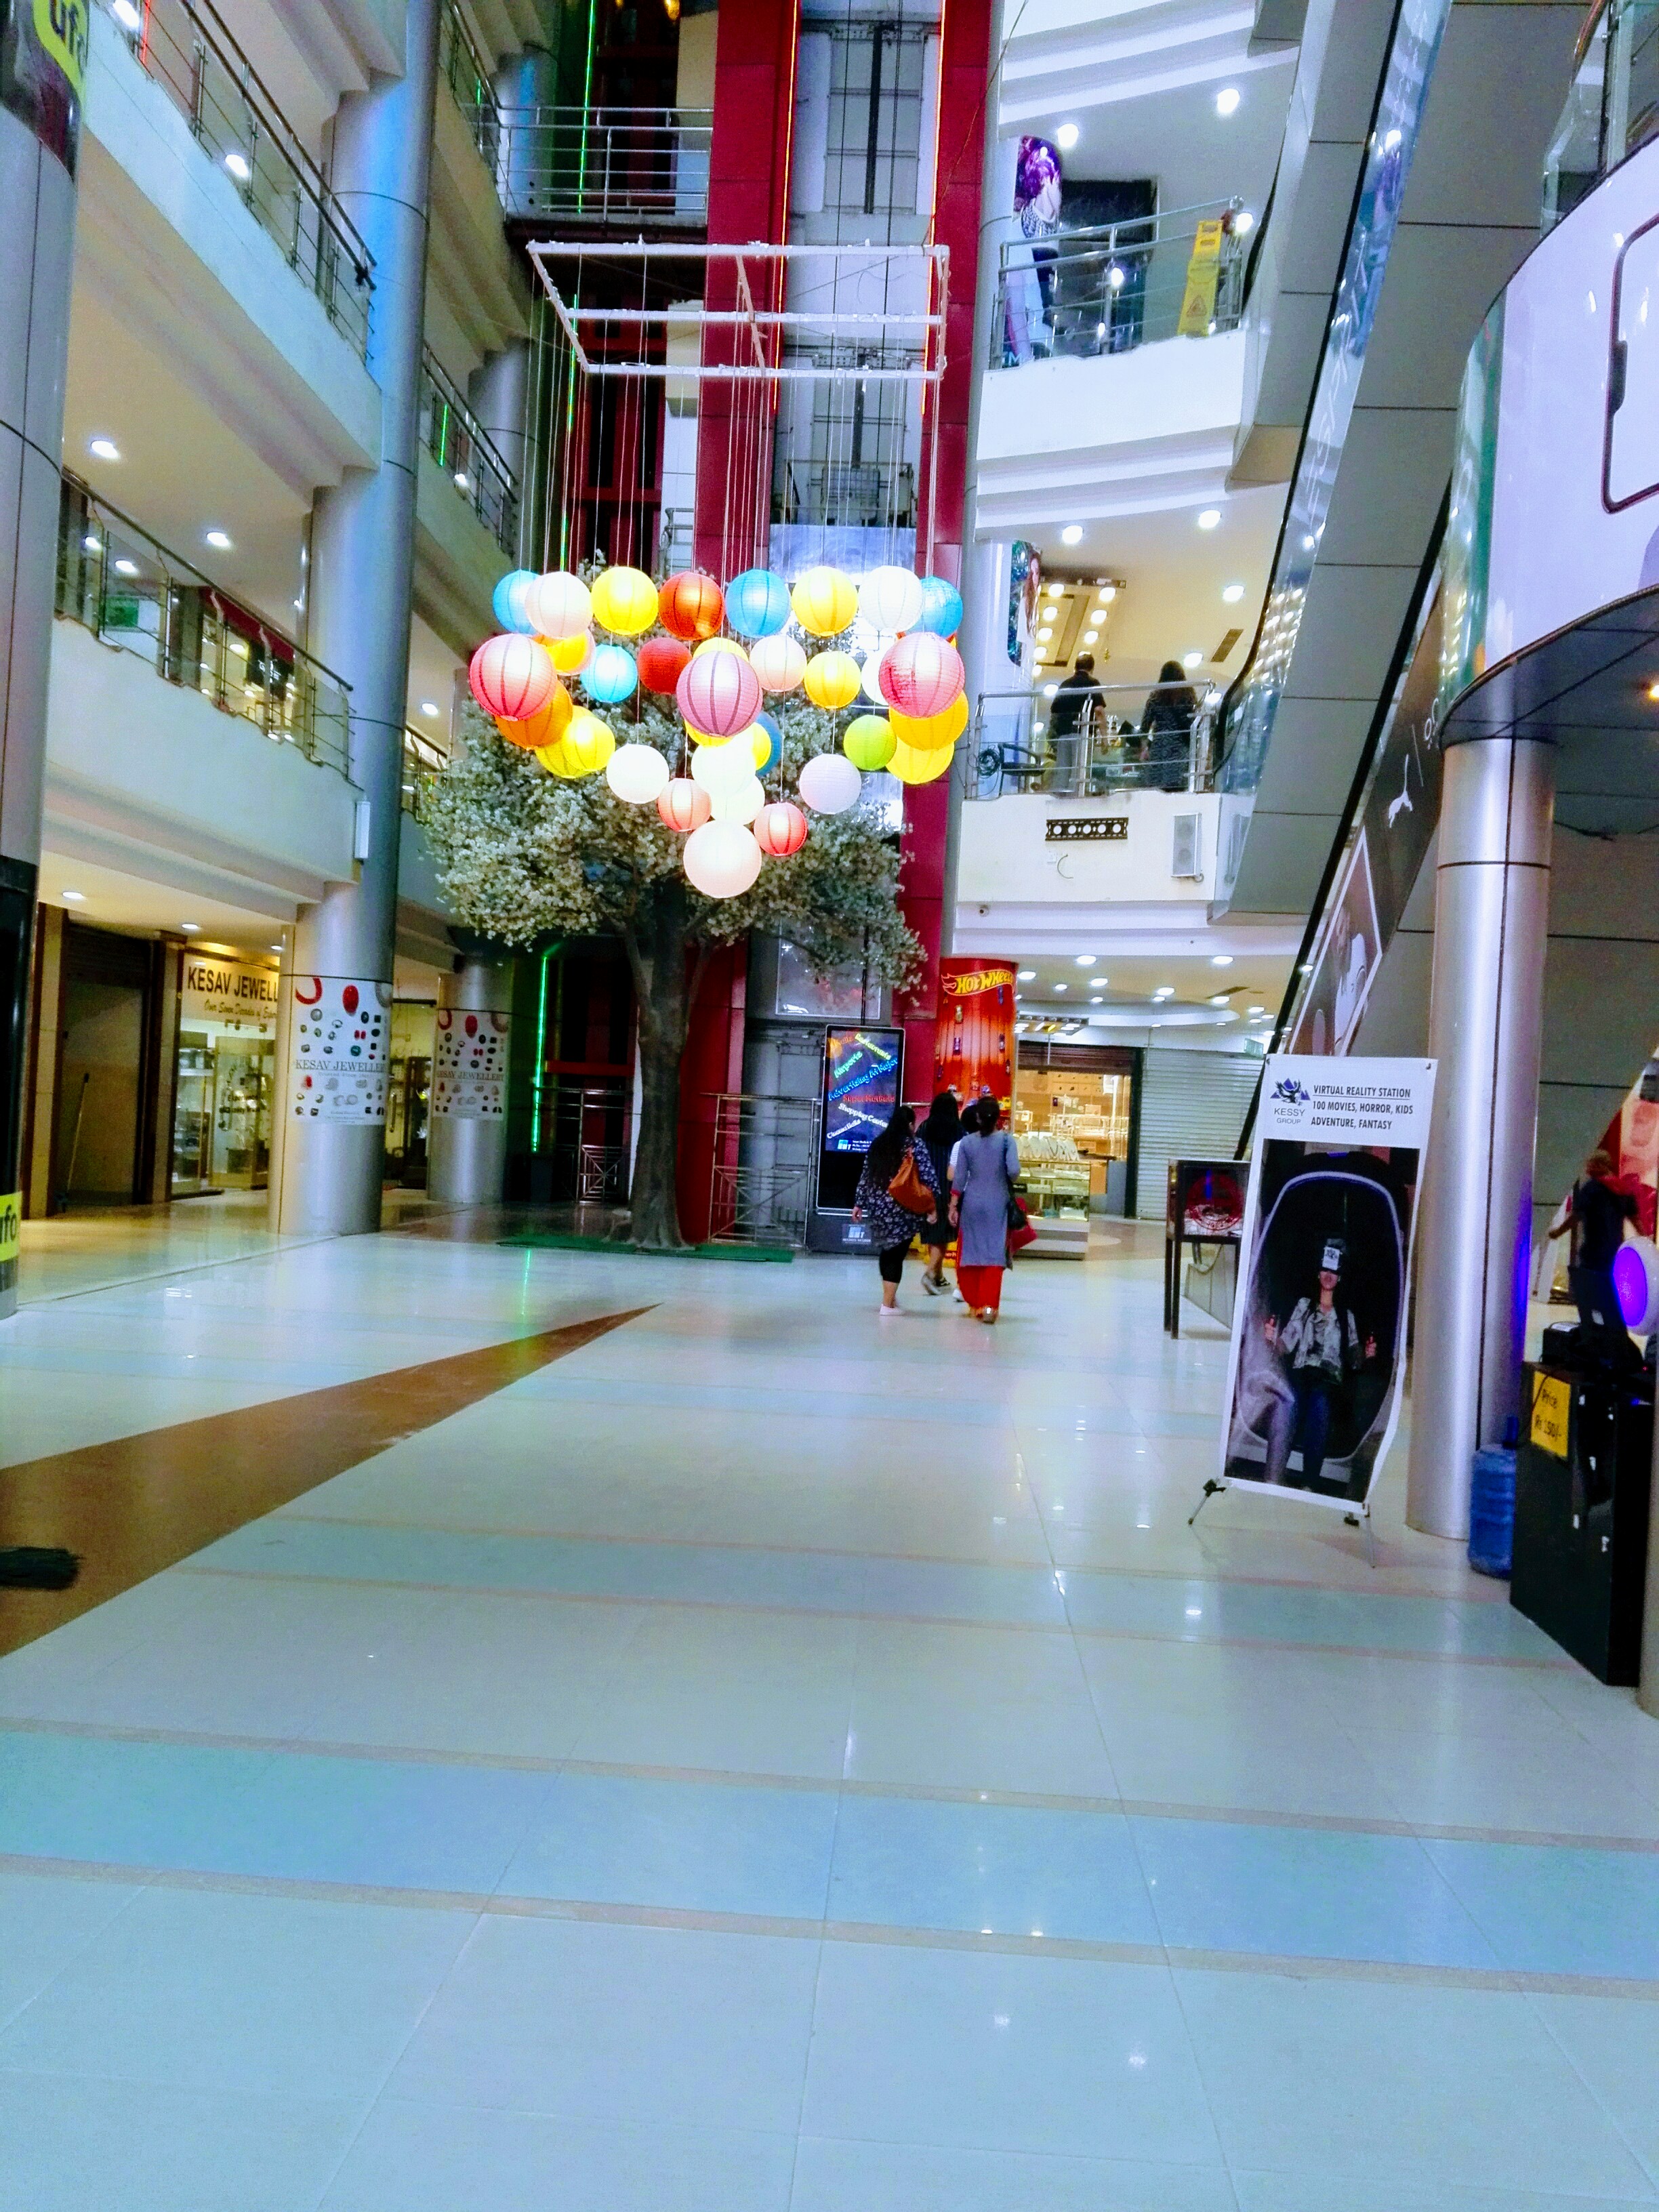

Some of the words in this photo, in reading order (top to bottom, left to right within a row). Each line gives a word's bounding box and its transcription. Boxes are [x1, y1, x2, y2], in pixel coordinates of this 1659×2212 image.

[188, 966, 231, 994] KESAV
[954, 976, 981, 994] HOT
[979, 971, 1013, 990] WHEEL
[295, 1059, 331, 1070] KESAV
[1313, 1085, 1345, 1095] VIRTUAL
[1347, 1087, 1376, 1097] REALITY
[1378, 1088, 1411, 1098] STATION
[838, 1103, 868, 1121] Shopping
[1274, 1107, 1305, 1116] KESSY
[1313, 1101, 1326, 1110] 100
[1328, 1102, 1357, 1113] MOVIES,
[1359, 1103, 1393, 1114] HORROR,
[1395, 1105, 1414, 1114] KIDS
[1311, 1117, 1356, 1129] ADVENTURE,
[1359, 1120, 1392, 1130] FANTASY
